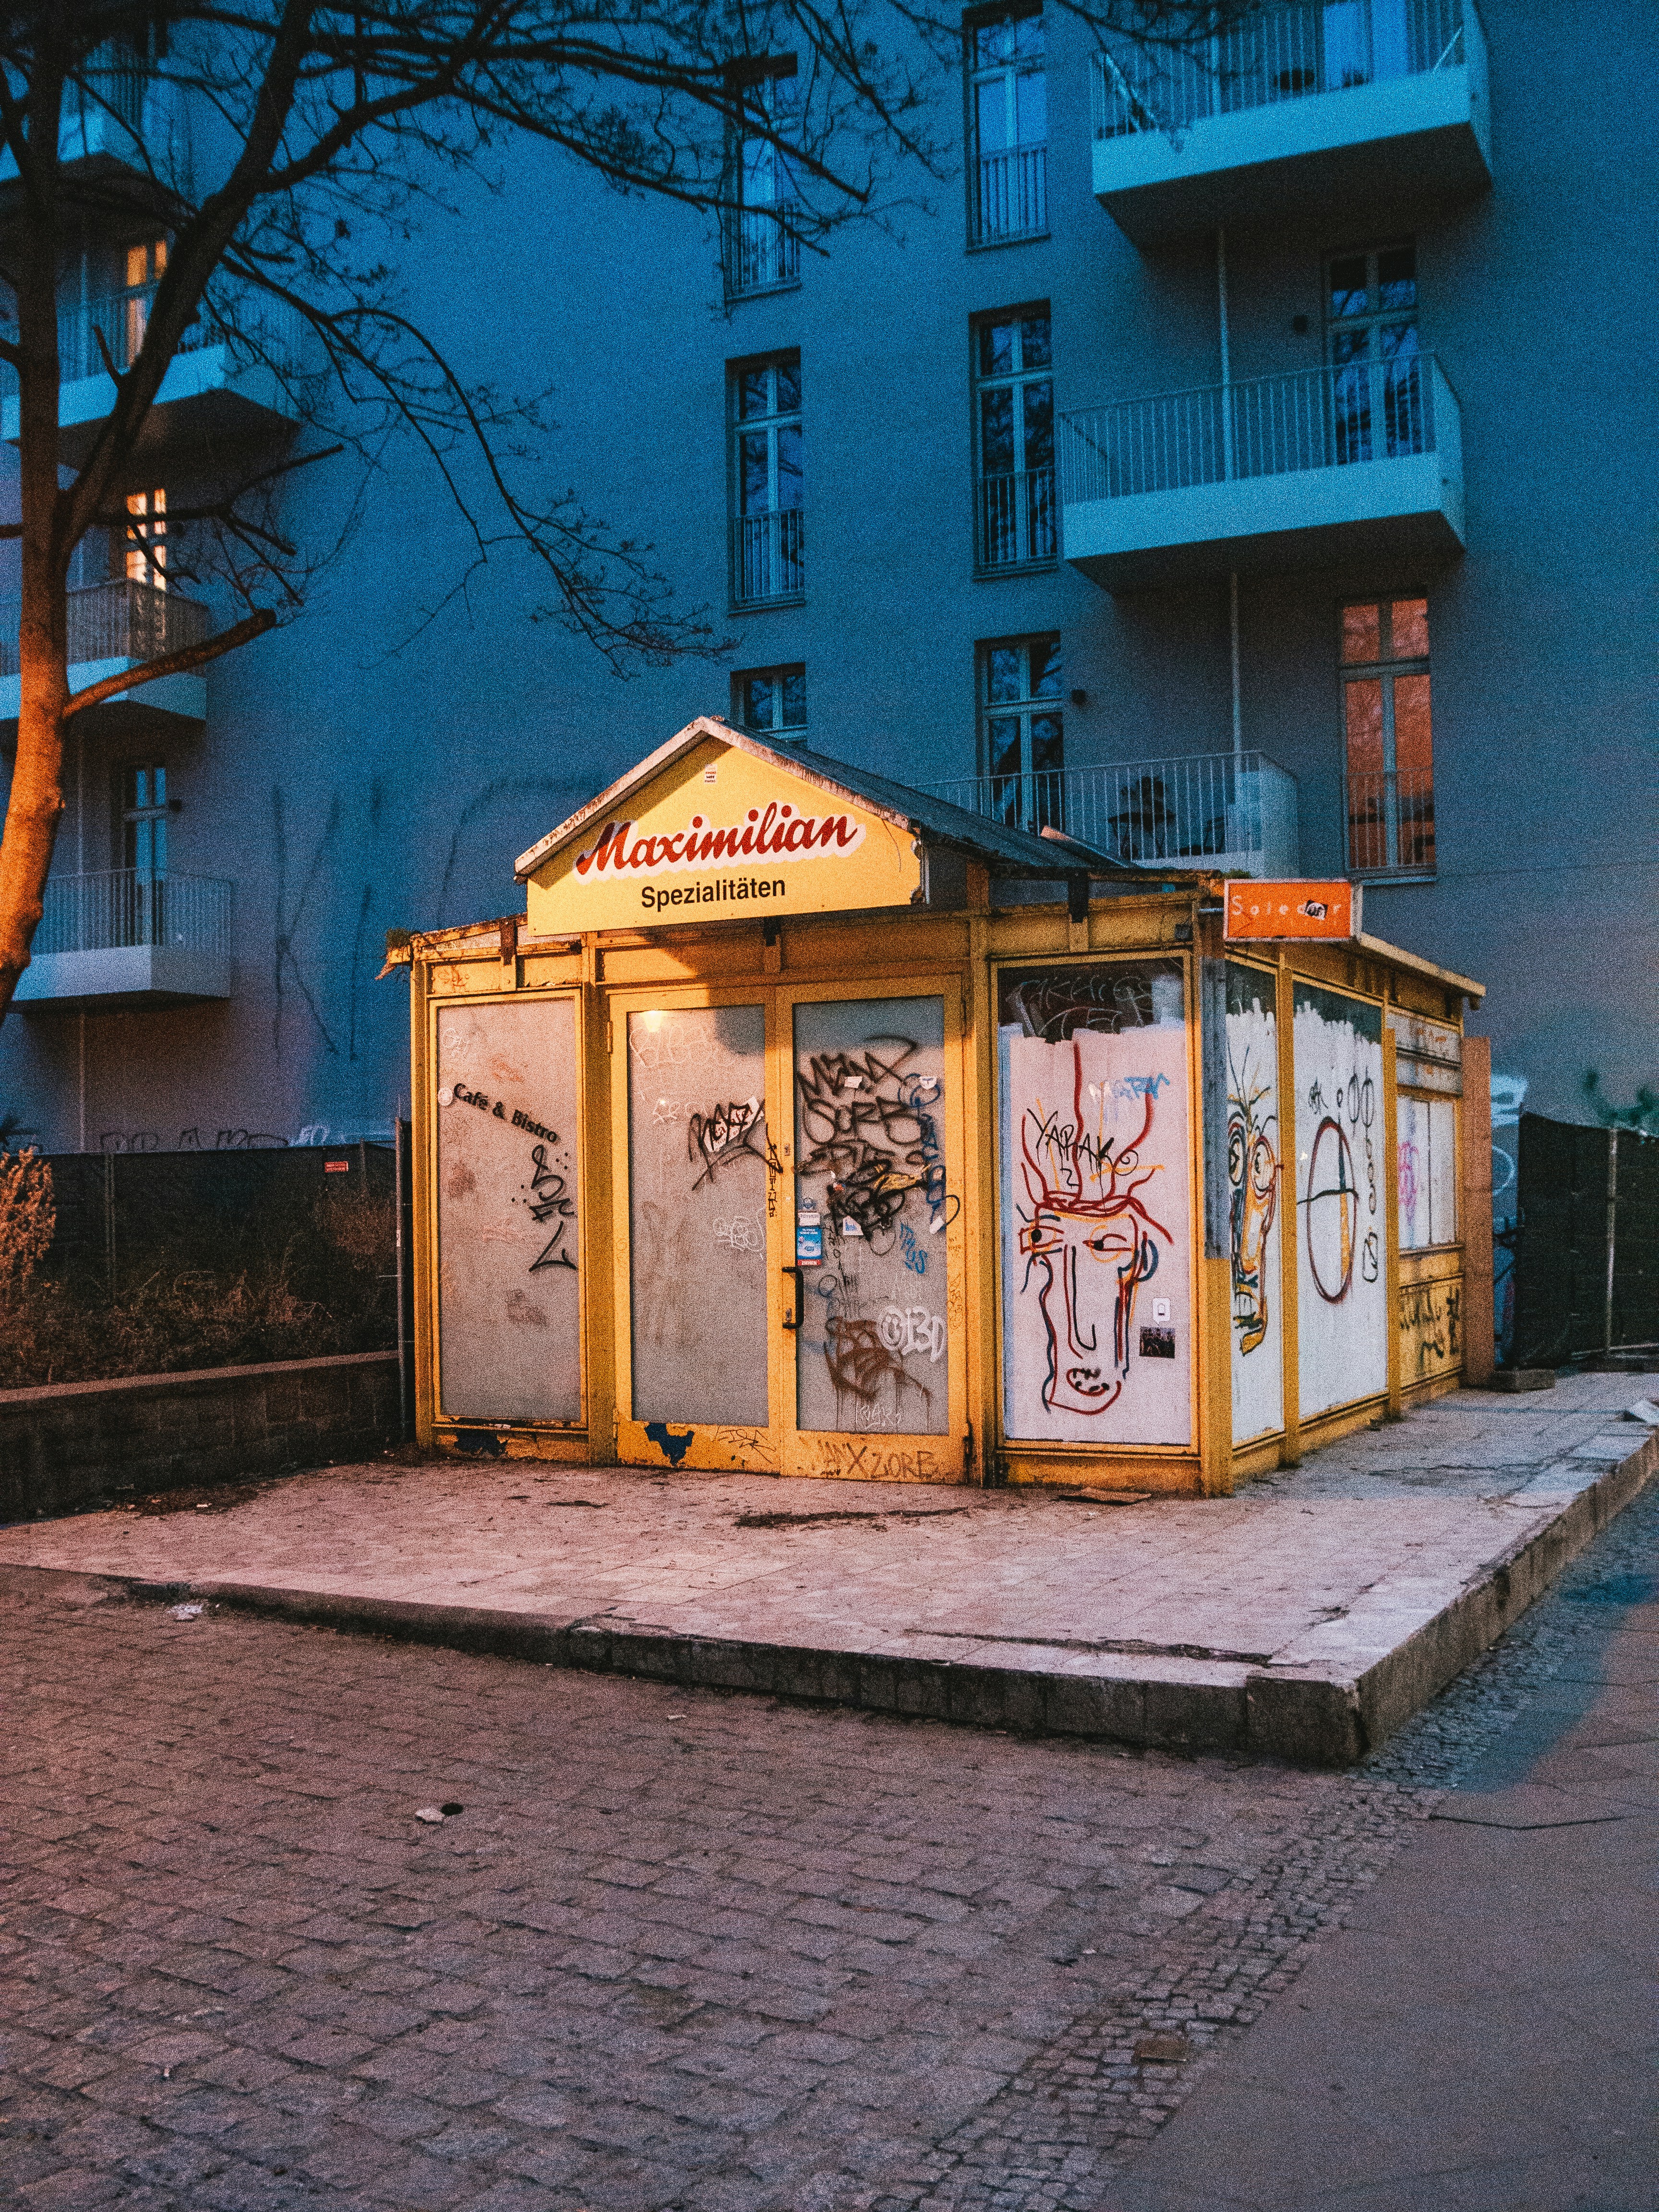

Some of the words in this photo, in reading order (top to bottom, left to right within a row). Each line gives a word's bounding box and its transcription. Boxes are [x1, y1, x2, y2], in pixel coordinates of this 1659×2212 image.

[577, 801, 858, 876] Maximilian
[641, 878, 786, 912] Spezialitäten
[453, 1082, 489, 1111] Café
[492, 1101, 507, 1120] &
[511, 1109, 559, 1143] Bistro
